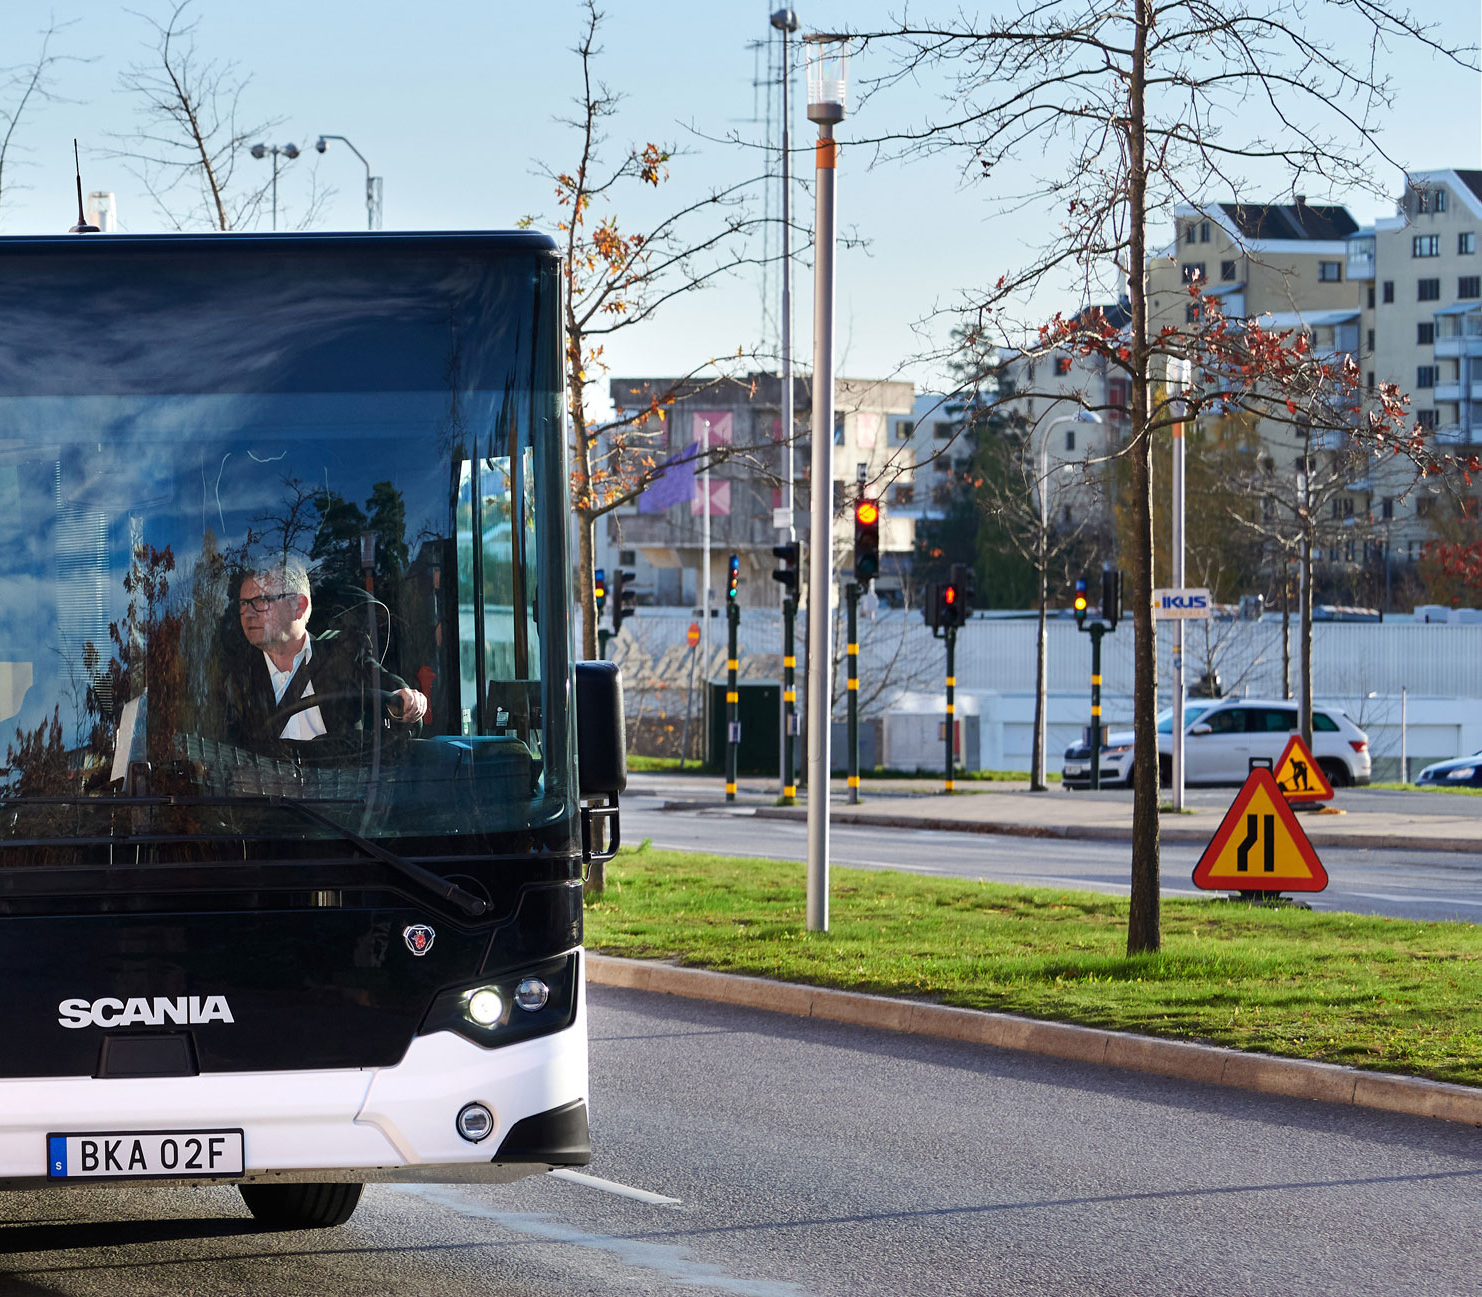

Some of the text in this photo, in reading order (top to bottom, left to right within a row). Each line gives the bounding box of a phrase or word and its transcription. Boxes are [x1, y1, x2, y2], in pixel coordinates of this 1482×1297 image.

[58, 995, 235, 1029] SCANIA
[55, 1161, 62, 1170] S
[81, 1138, 225, 1171] BKA 02F
